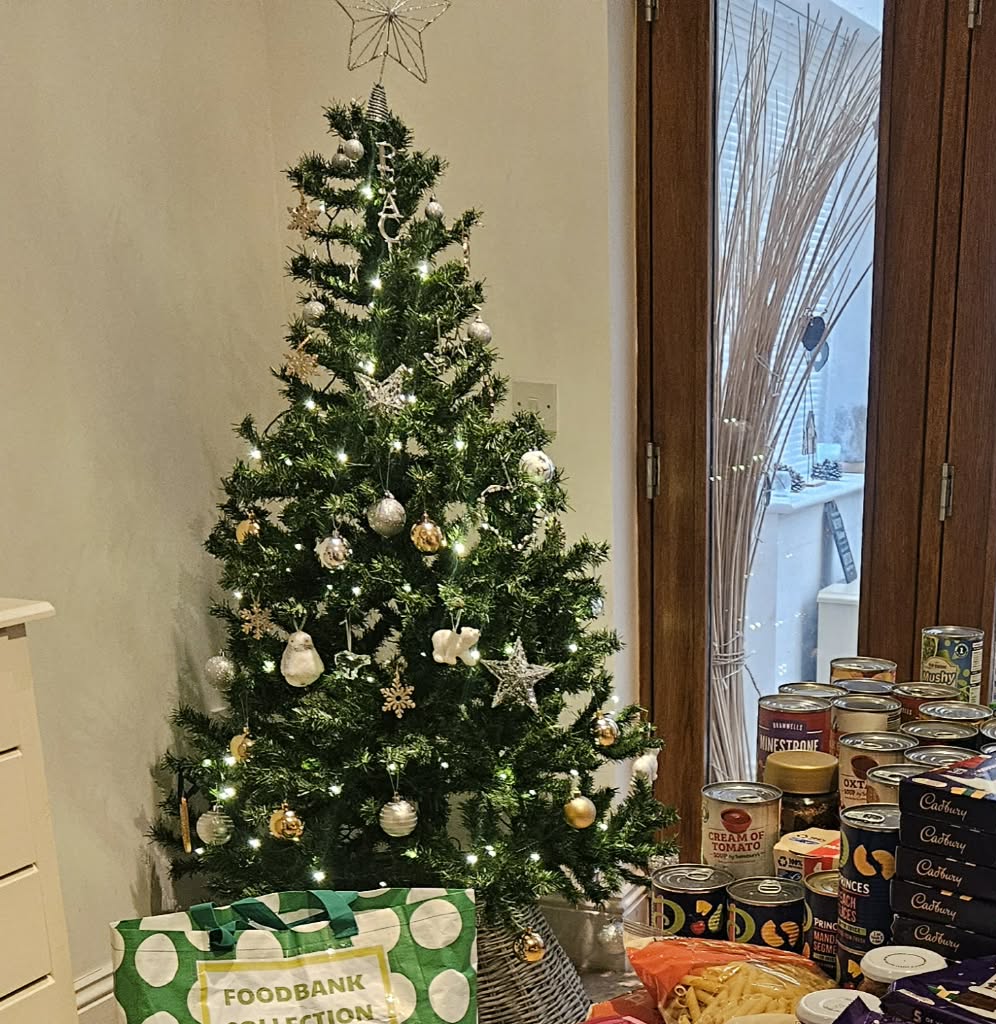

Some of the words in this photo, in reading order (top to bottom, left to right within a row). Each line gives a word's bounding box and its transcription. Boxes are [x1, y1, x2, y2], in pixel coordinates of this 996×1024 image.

[760, 734, 819, 752] MINESTRONE
[919, 793, 967, 820] Cadbury
[708, 832, 748, 842] CREAM
[750, 831, 765, 840] OF
[712, 842, 760, 852] TOMATO
[920, 826, 966, 853] Cadbury
[916, 859, 962, 886] Cadbury
[912, 893, 956, 920] Cadbury
[914, 926, 960, 952] Cadbury
[224, 974, 365, 1006] FOODBANK
[912, 1010, 922, 1024] 5
[924, 1016, 934, 1024] OF
